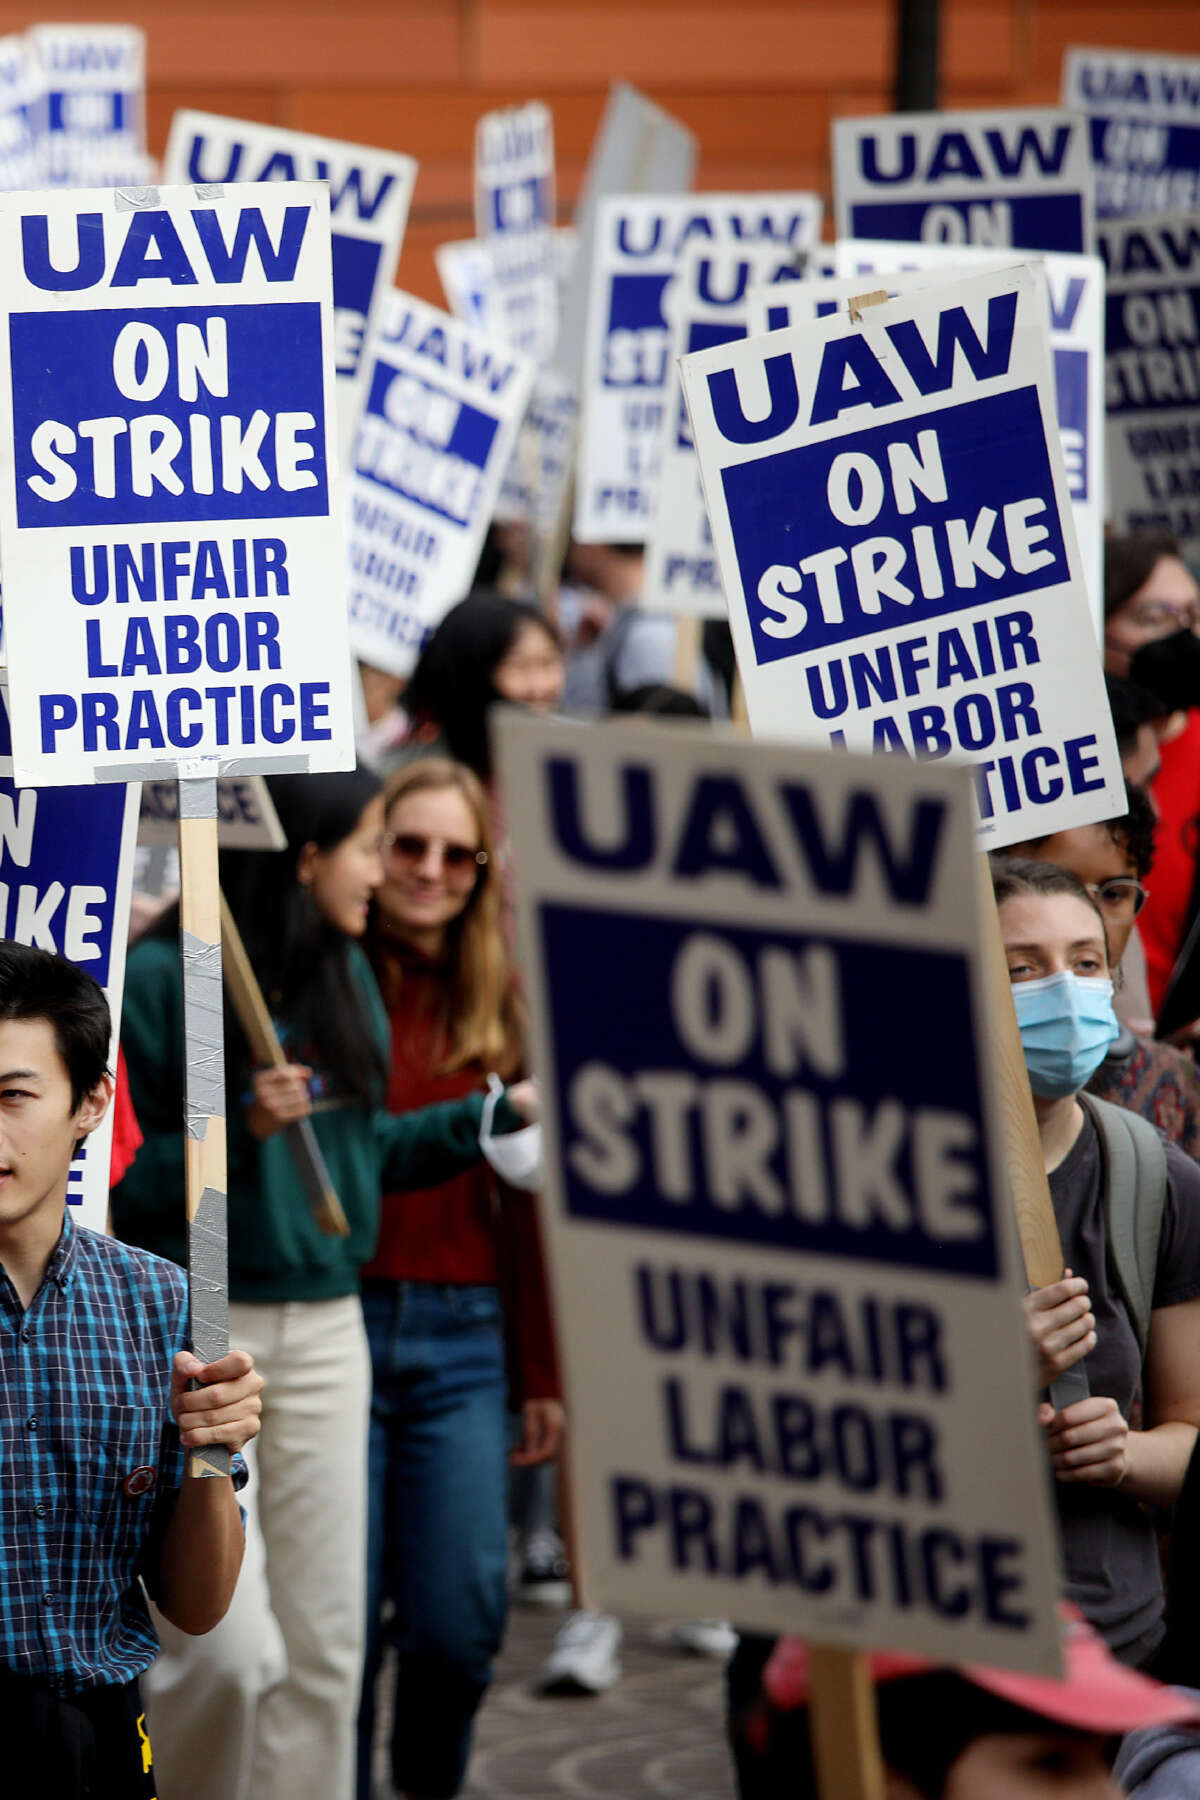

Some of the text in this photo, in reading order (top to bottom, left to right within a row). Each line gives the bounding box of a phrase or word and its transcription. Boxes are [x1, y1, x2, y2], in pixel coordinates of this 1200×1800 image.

[860, 126, 1071, 183] UAW
[21, 206, 311, 292] UAW
[112, 316, 230, 402] ON
[707, 291, 1018, 445] UAW
[26, 409, 319, 502] STRIKE
[827, 429, 948, 526] ON
[69, 538, 290, 606] UNFAIR
[757, 497, 1056, 639] STRIKE
[85, 611, 282, 679] LABOR
[805, 611, 1040, 719] UNFAIR
[39, 682, 333, 754] PRACTICE
[543, 755, 950, 907] UAW
[671, 932, 845, 1078] ON
[568, 1062, 988, 1240] STRIKE
[634, 1256, 950, 1395] UNFAIR
[662, 1373, 944, 1506] LABOR
[610, 1473, 1033, 1630] PRACTICE
